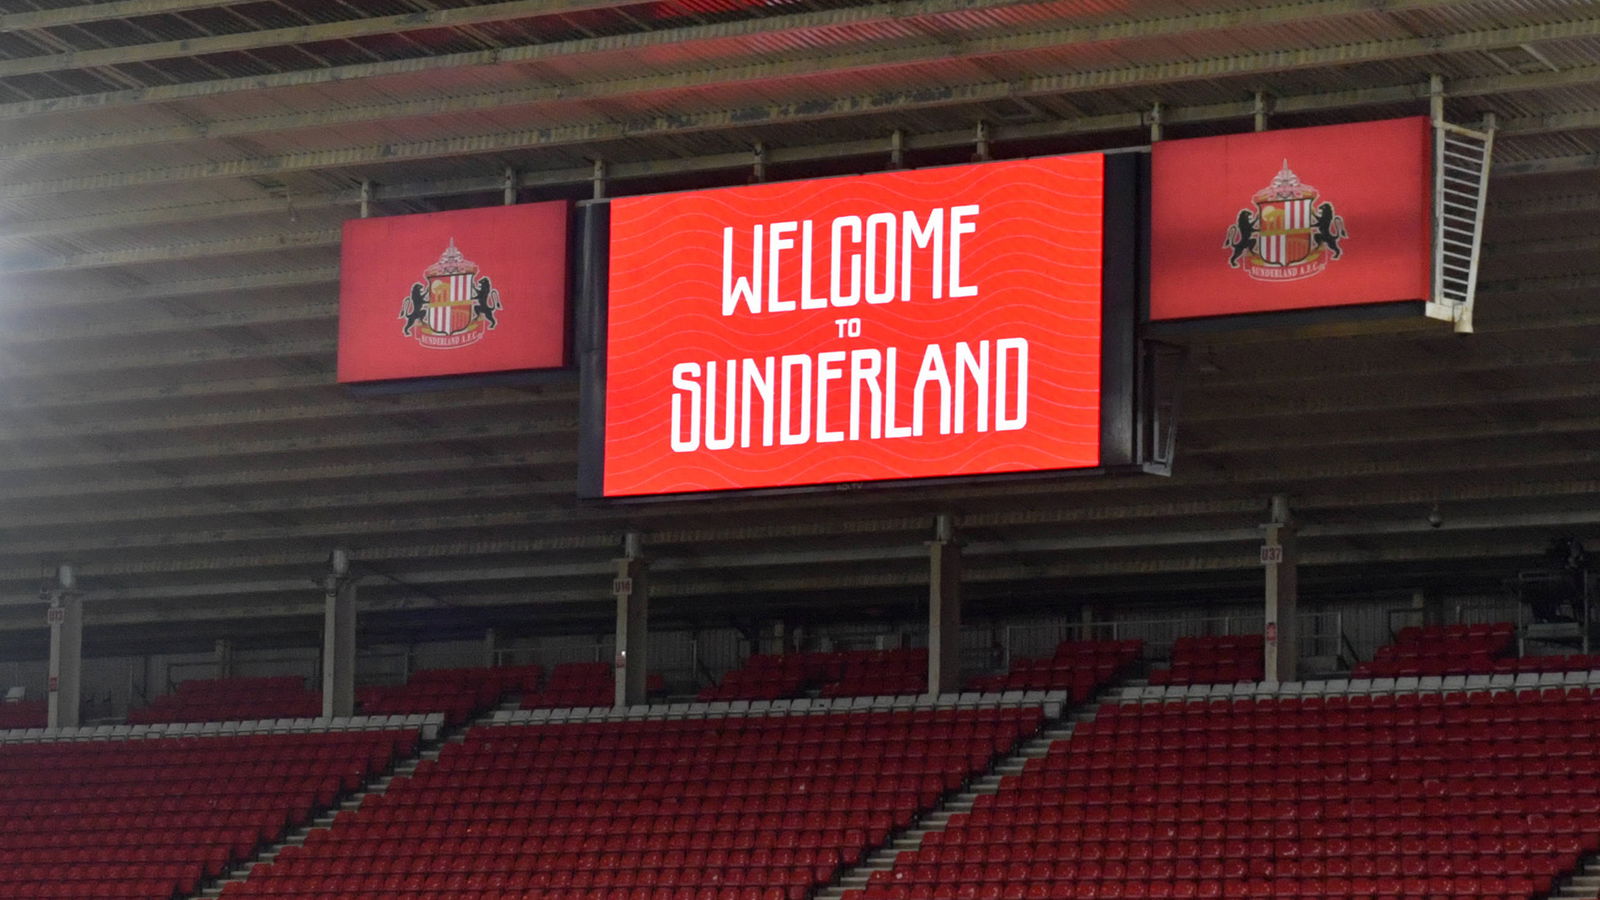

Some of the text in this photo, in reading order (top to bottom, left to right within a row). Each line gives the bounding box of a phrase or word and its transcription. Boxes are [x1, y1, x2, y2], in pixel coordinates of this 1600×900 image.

[722, 205, 979, 316] WELCOME
[1250, 265, 1298, 278] SUNDERLAND
[835, 318, 862, 338] TO
[421, 333, 460, 346] SUNDERLAND
[670, 337, 1029, 453] SUNDERLAND
